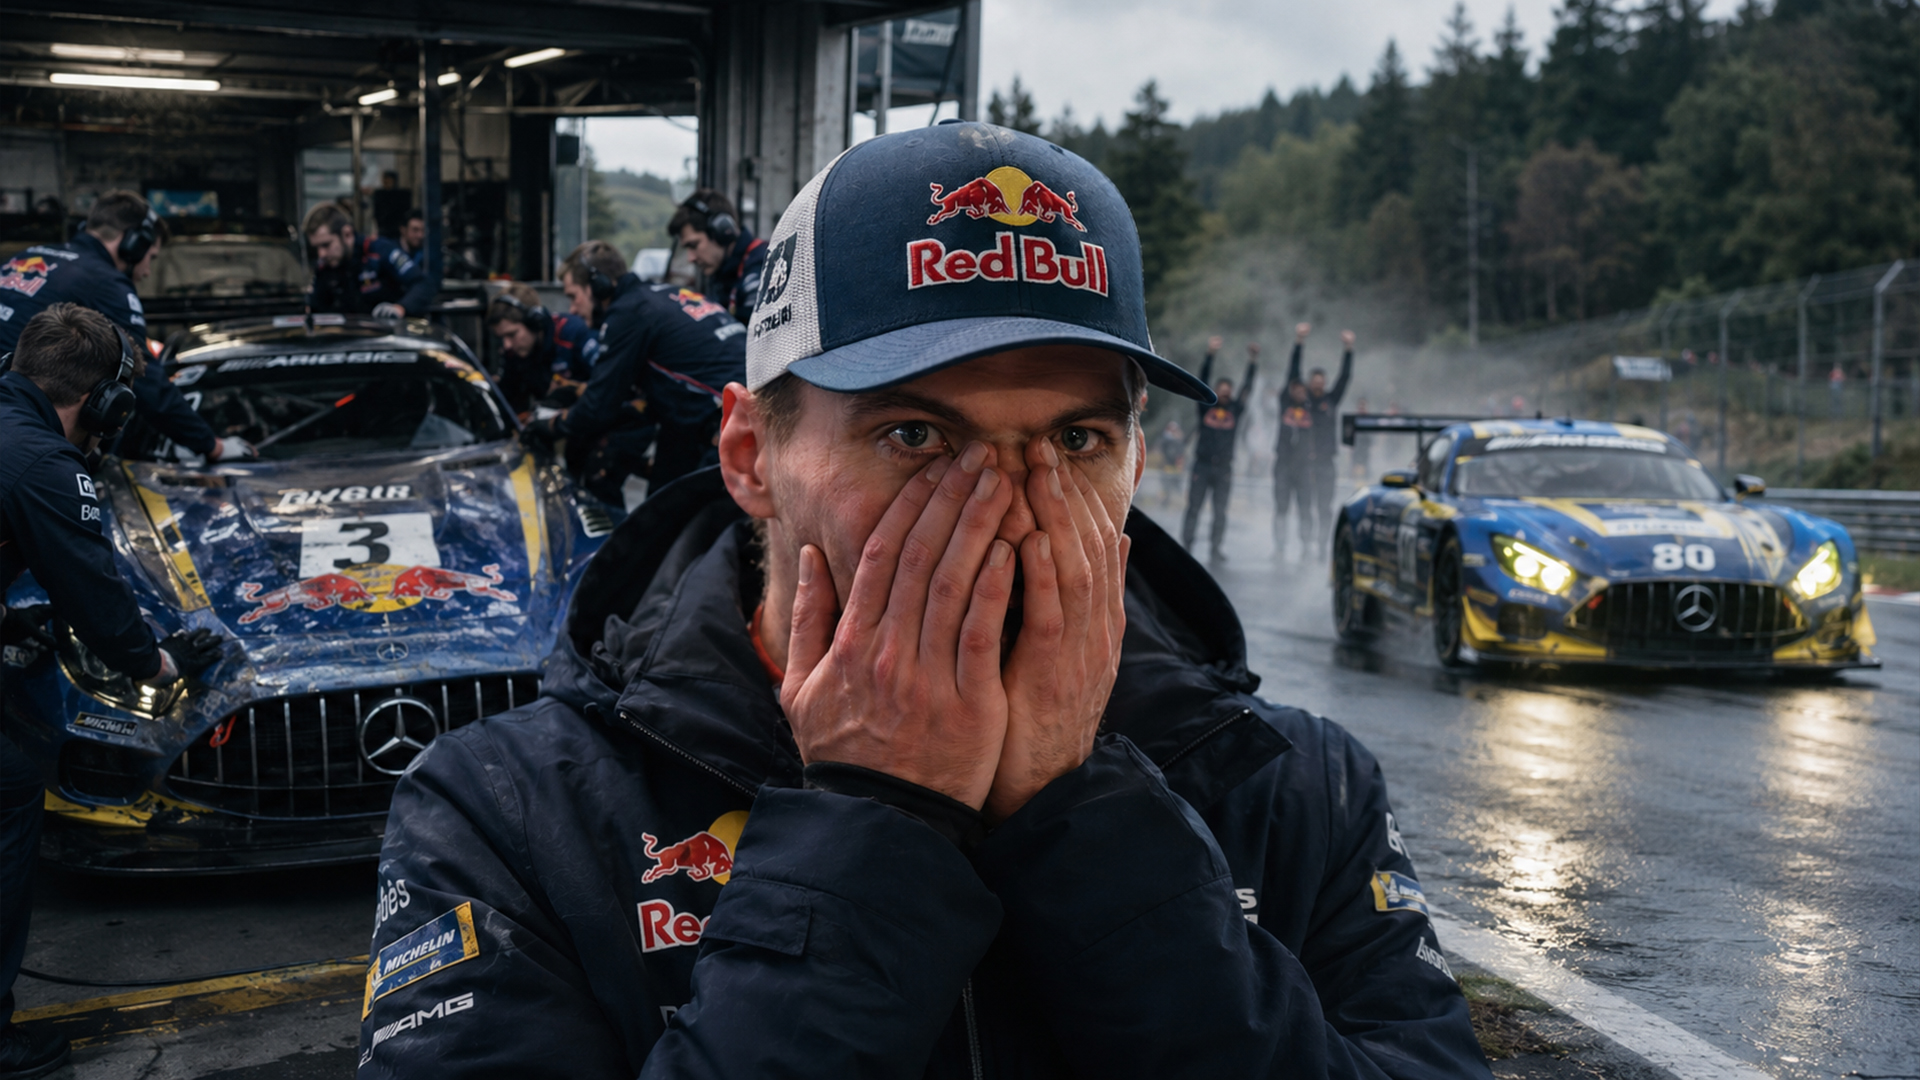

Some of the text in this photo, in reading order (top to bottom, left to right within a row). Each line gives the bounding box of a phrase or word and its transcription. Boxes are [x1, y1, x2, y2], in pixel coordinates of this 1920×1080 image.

[907, 231, 1108, 297] Red Bull
[333, 521, 390, 570] 3
[1653, 543, 1715, 571] 80
[637, 898, 711, 953] Re
[384, 929, 455, 975] MICHELIN
[390, 991, 474, 1038] AMG
